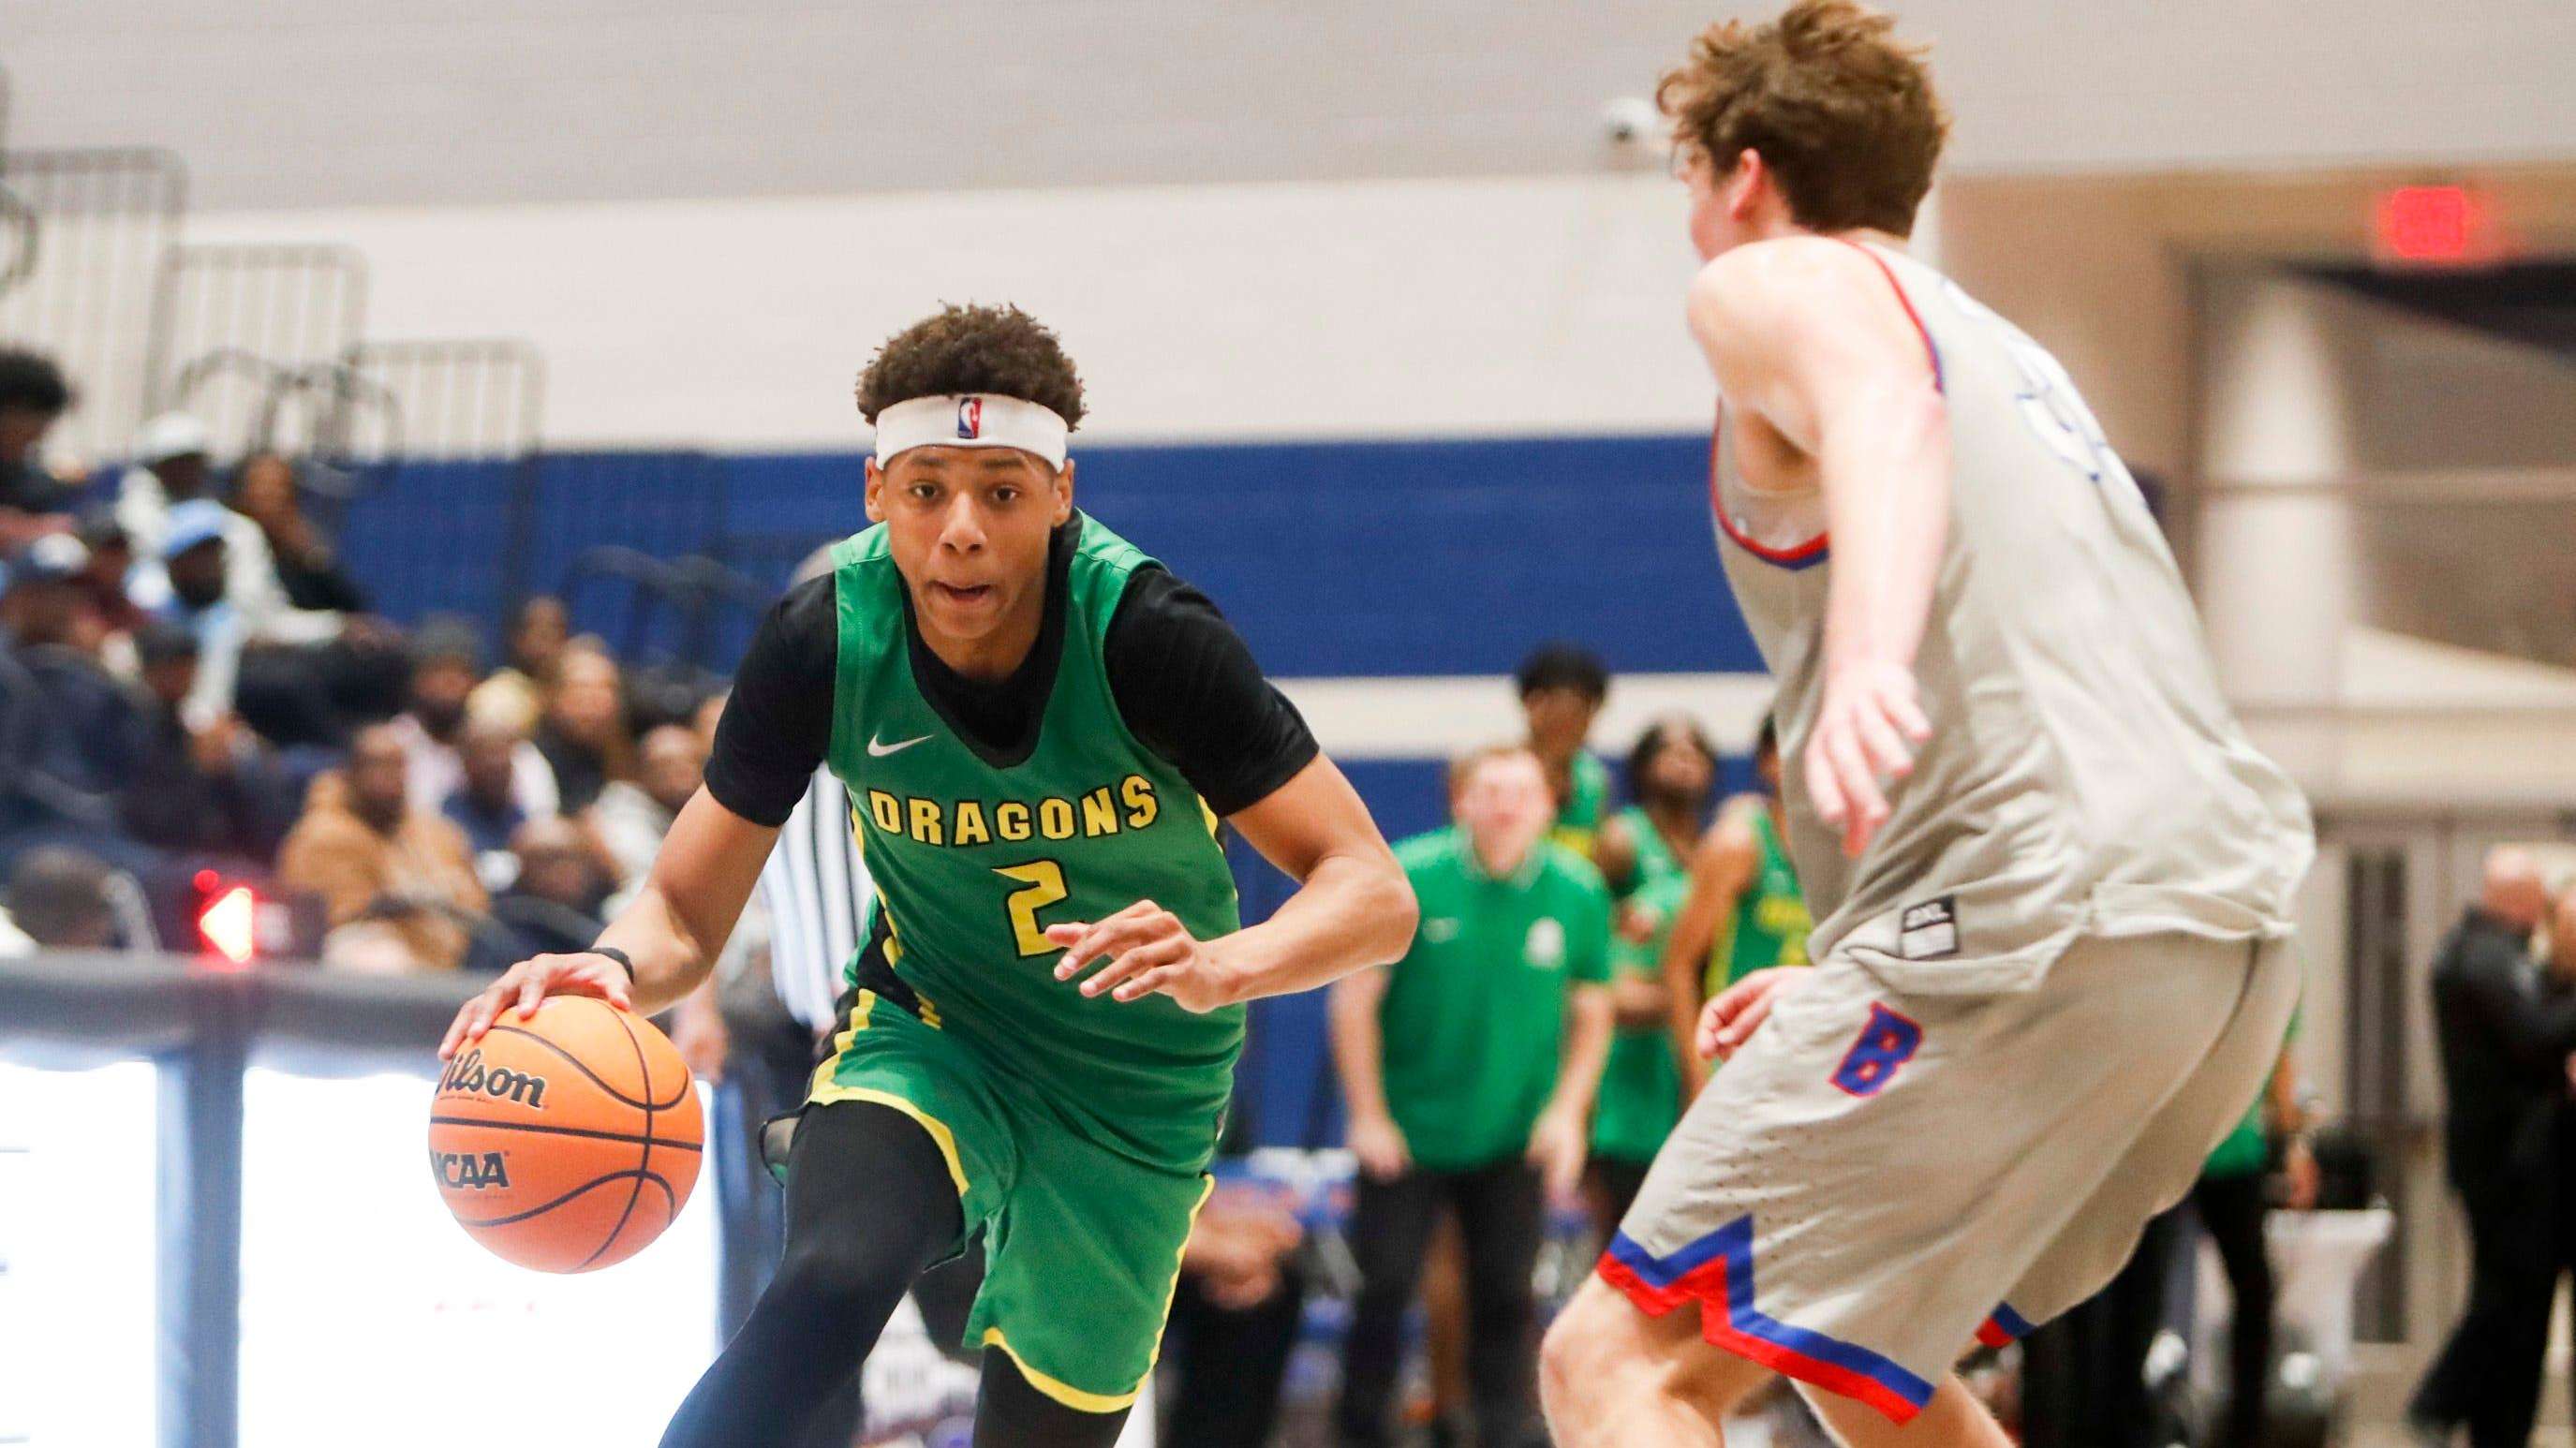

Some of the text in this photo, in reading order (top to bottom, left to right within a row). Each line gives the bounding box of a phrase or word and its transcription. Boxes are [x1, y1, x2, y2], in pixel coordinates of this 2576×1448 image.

[867, 774, 1160, 847] DRAGONS
[990, 857, 1072, 959] 2
[1828, 1001, 1924, 1098] B
